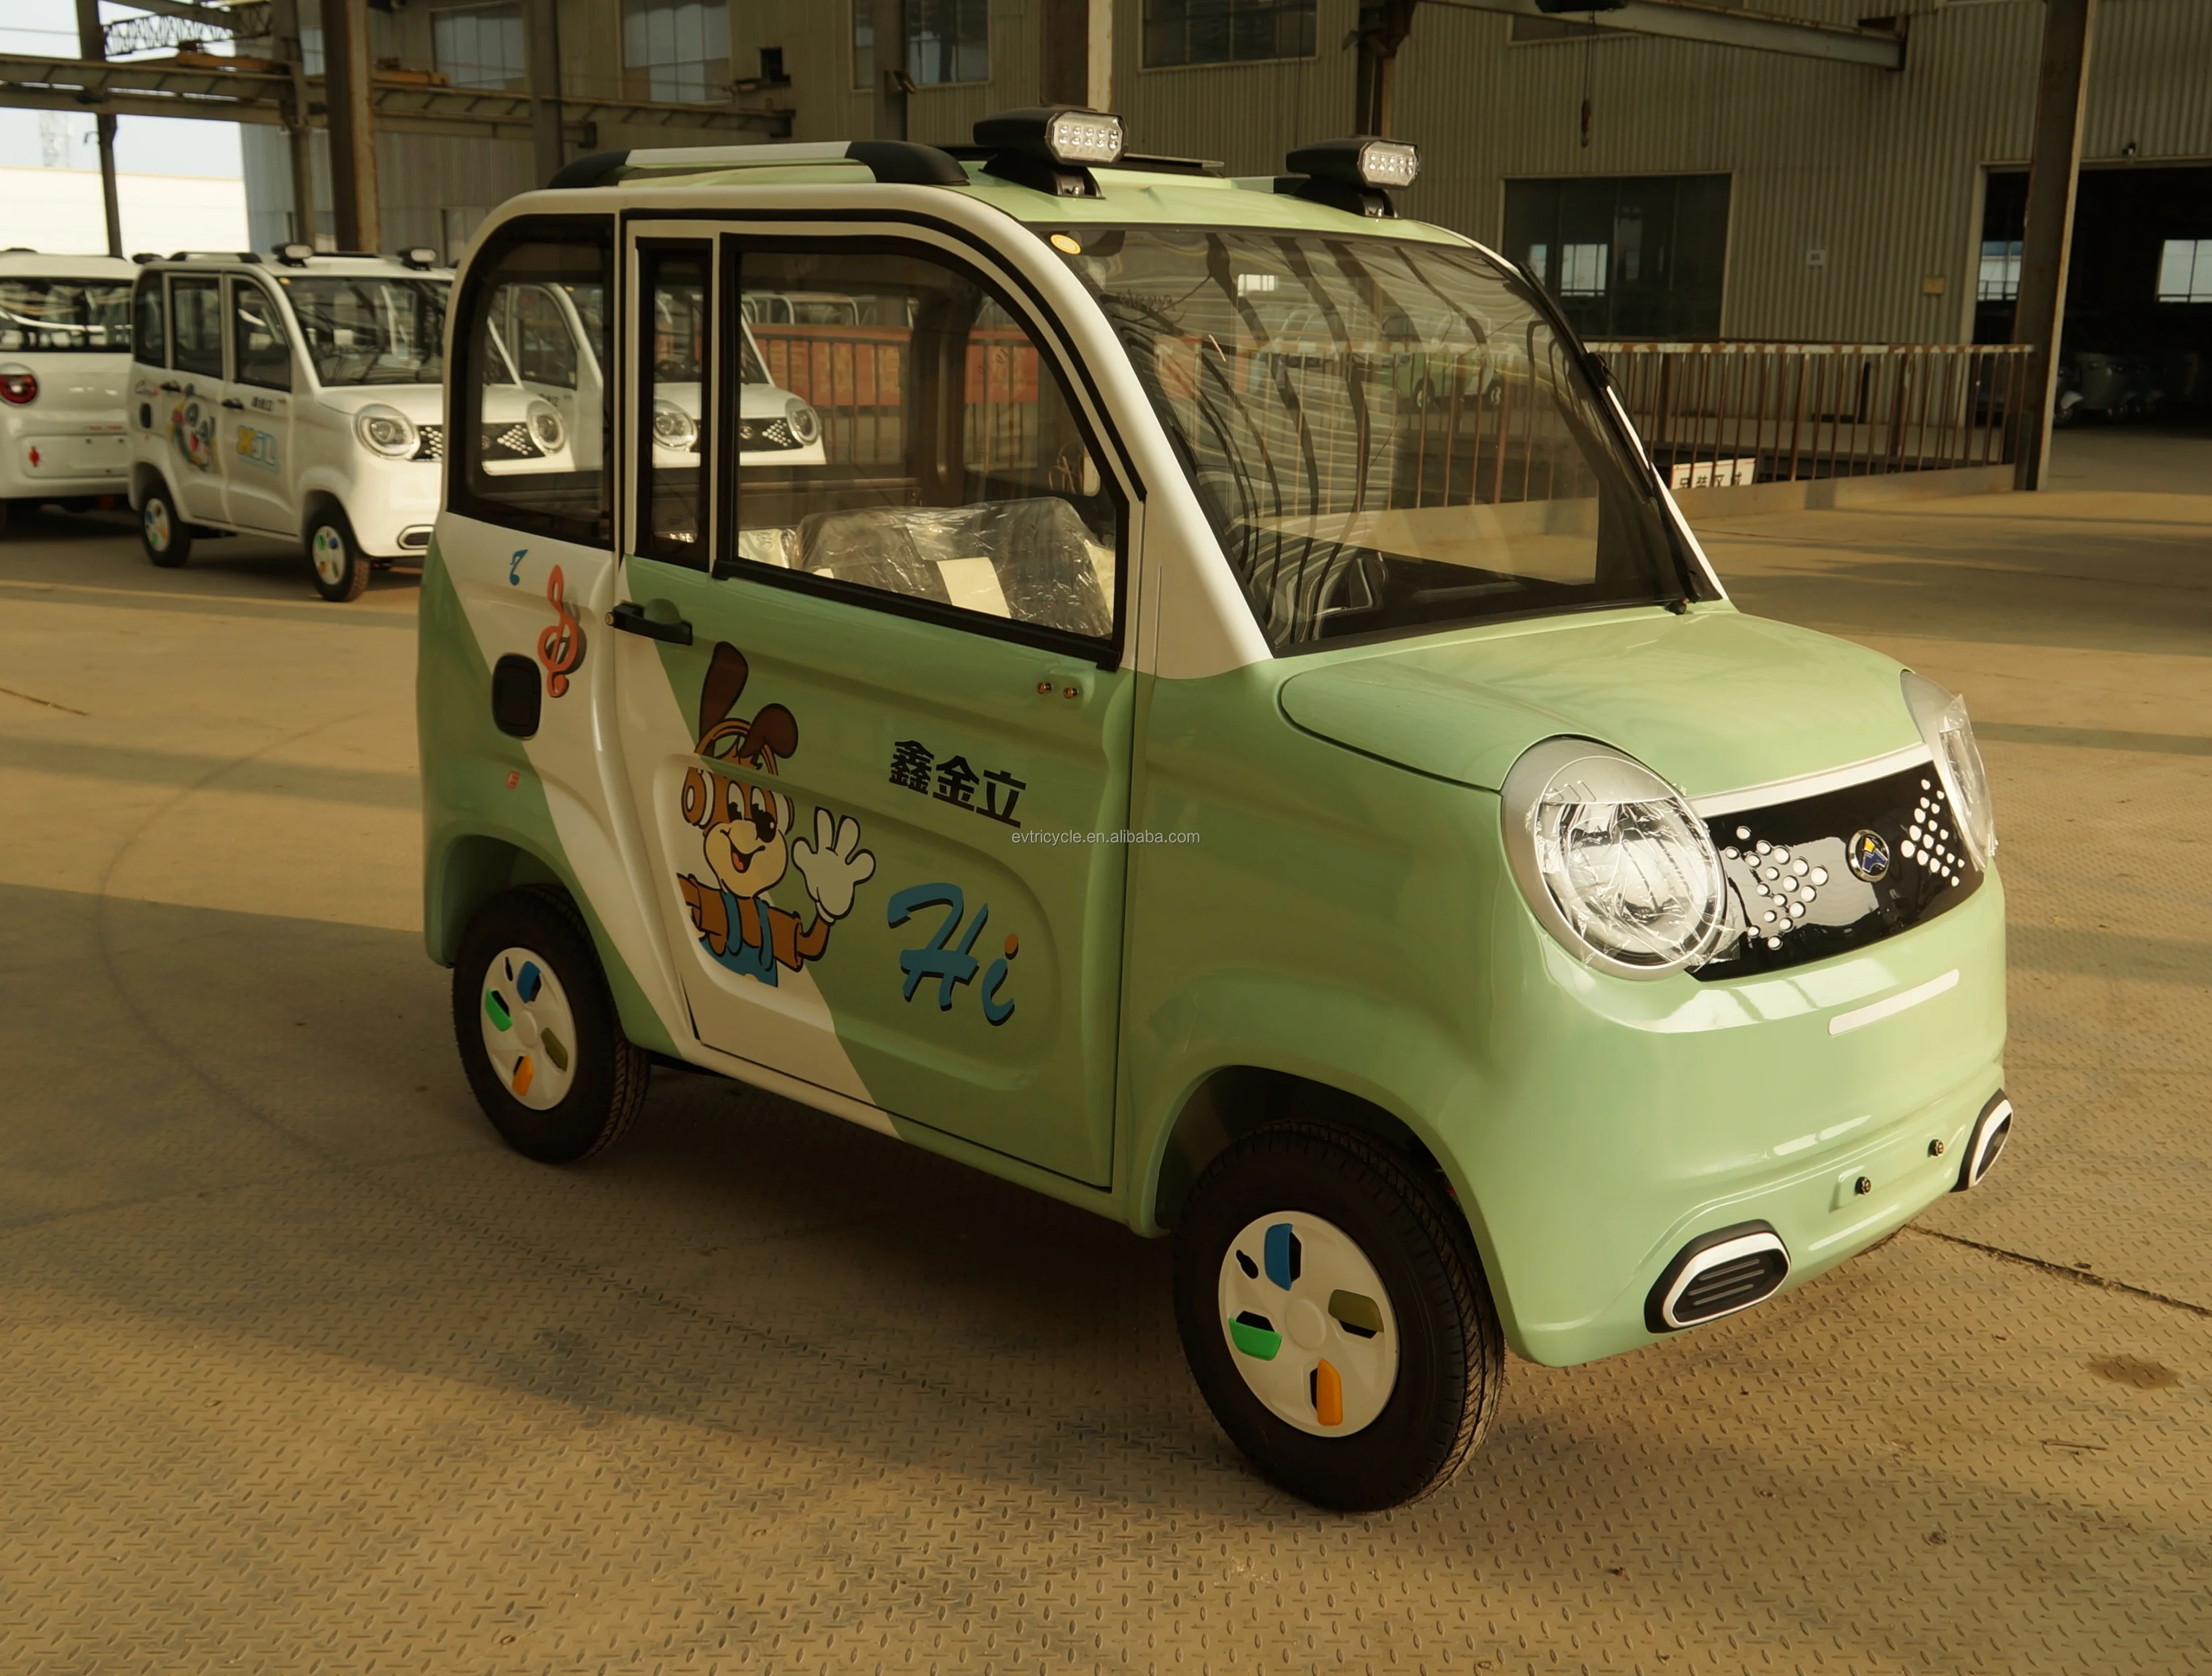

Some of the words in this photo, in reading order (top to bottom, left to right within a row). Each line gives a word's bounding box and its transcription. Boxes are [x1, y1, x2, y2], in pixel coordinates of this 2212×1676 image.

[889, 740, 1026, 829] 鑫金立
[887, 883, 1019, 1026] Hi
